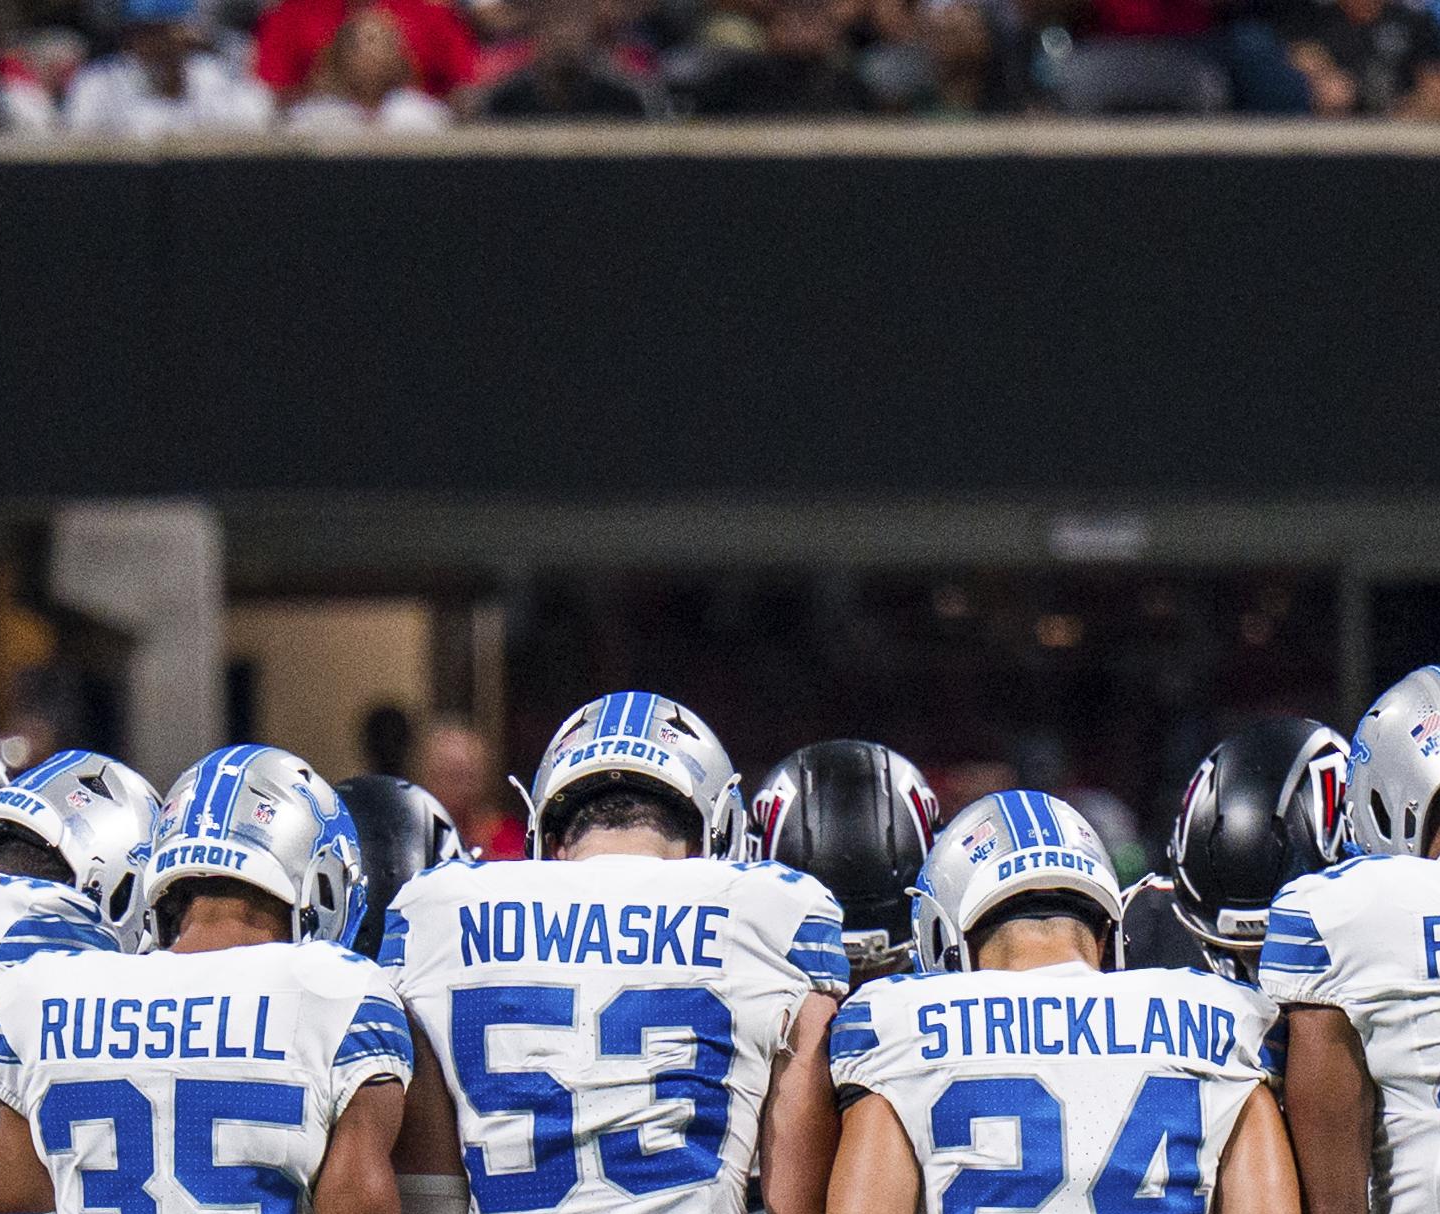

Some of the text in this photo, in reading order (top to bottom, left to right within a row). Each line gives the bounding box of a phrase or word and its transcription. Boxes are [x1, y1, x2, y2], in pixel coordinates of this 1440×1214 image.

[569, 740, 670, 768] DETROIT
[156, 844, 248, 874] DETROIT
[998, 851, 1096, 882] DETROIT
[459, 901, 730, 969] NOWASKE
[41, 995, 286, 1061] RUSSELL
[917, 996, 1237, 1068] STRICKLAND
